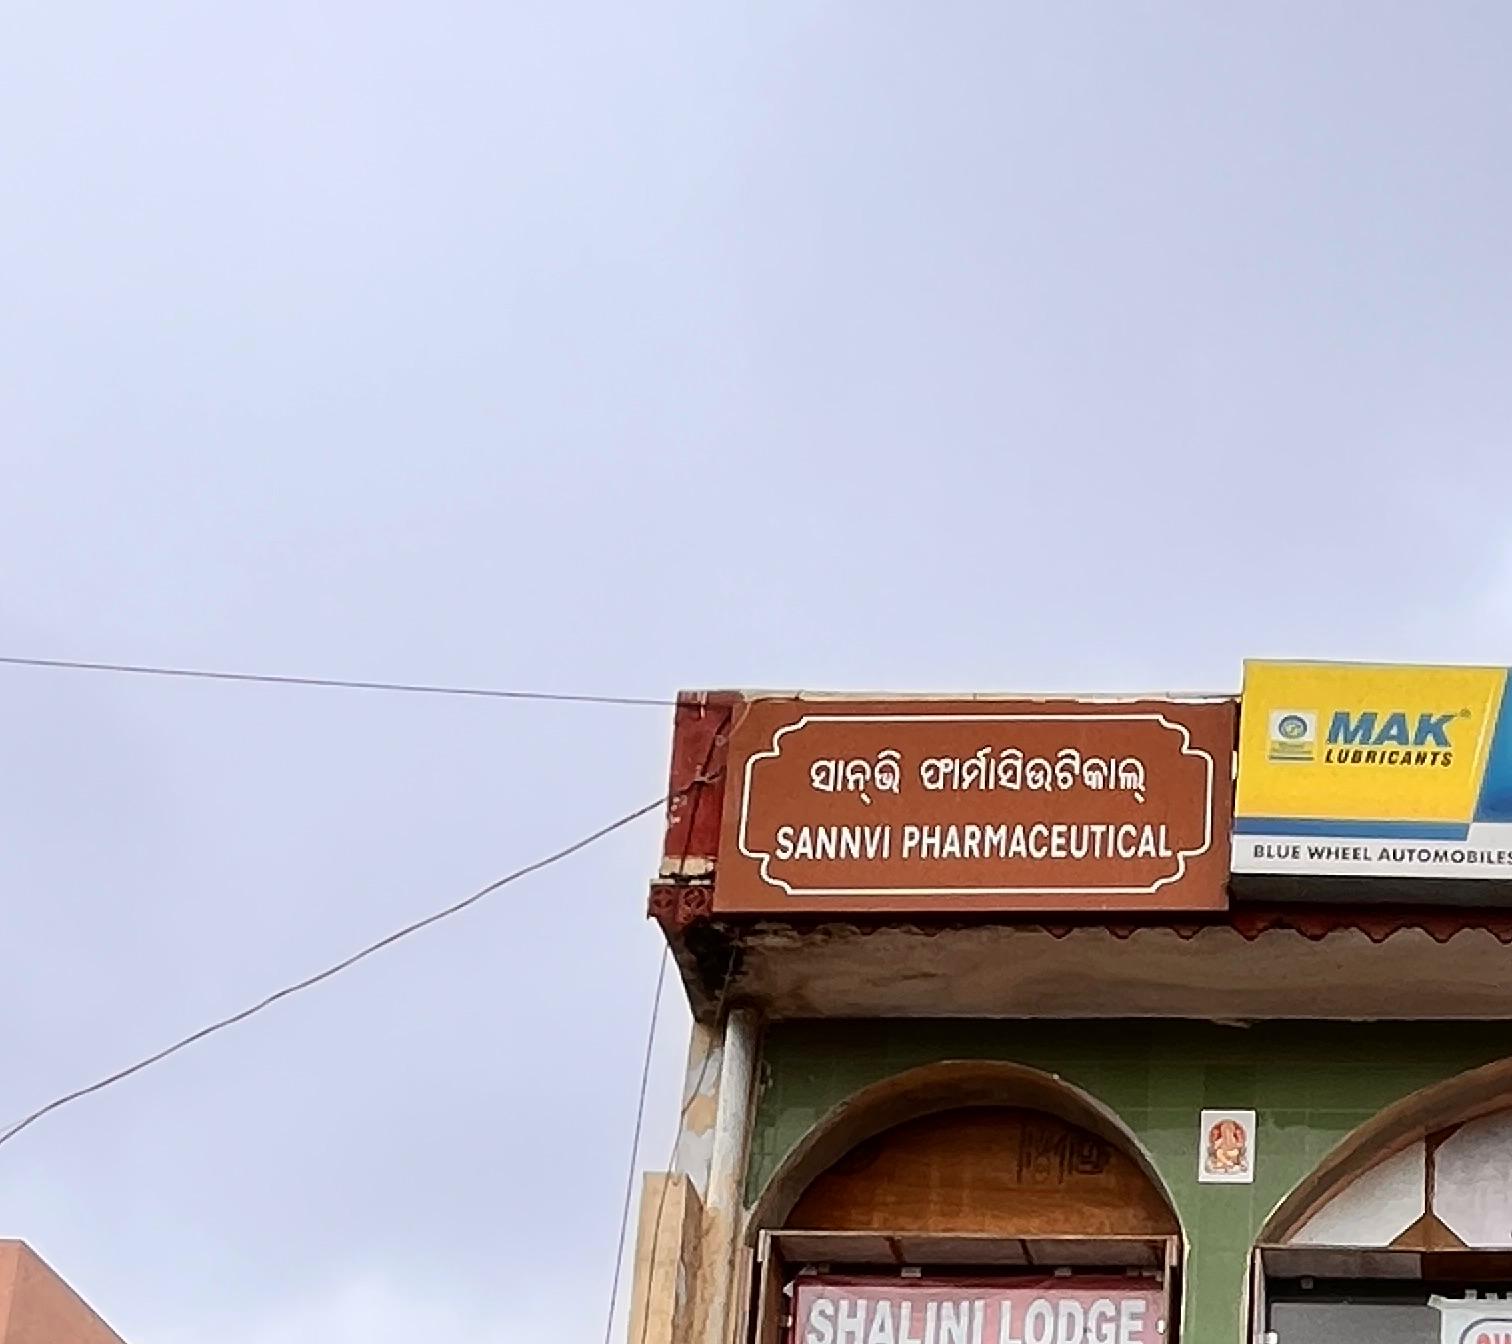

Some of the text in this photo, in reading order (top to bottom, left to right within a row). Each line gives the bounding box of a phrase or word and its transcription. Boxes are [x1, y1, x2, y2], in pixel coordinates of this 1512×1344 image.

[1327, 711, 1452, 747] MAK
[1325, 749, 1452, 767] LUBRICANTS
[776, 824, 1172, 860] SANNVI PHARMACEUTICAL
[1253, 845, 1300, 860] BLUE
[1308, 846, 1371, 862] WHEEL
